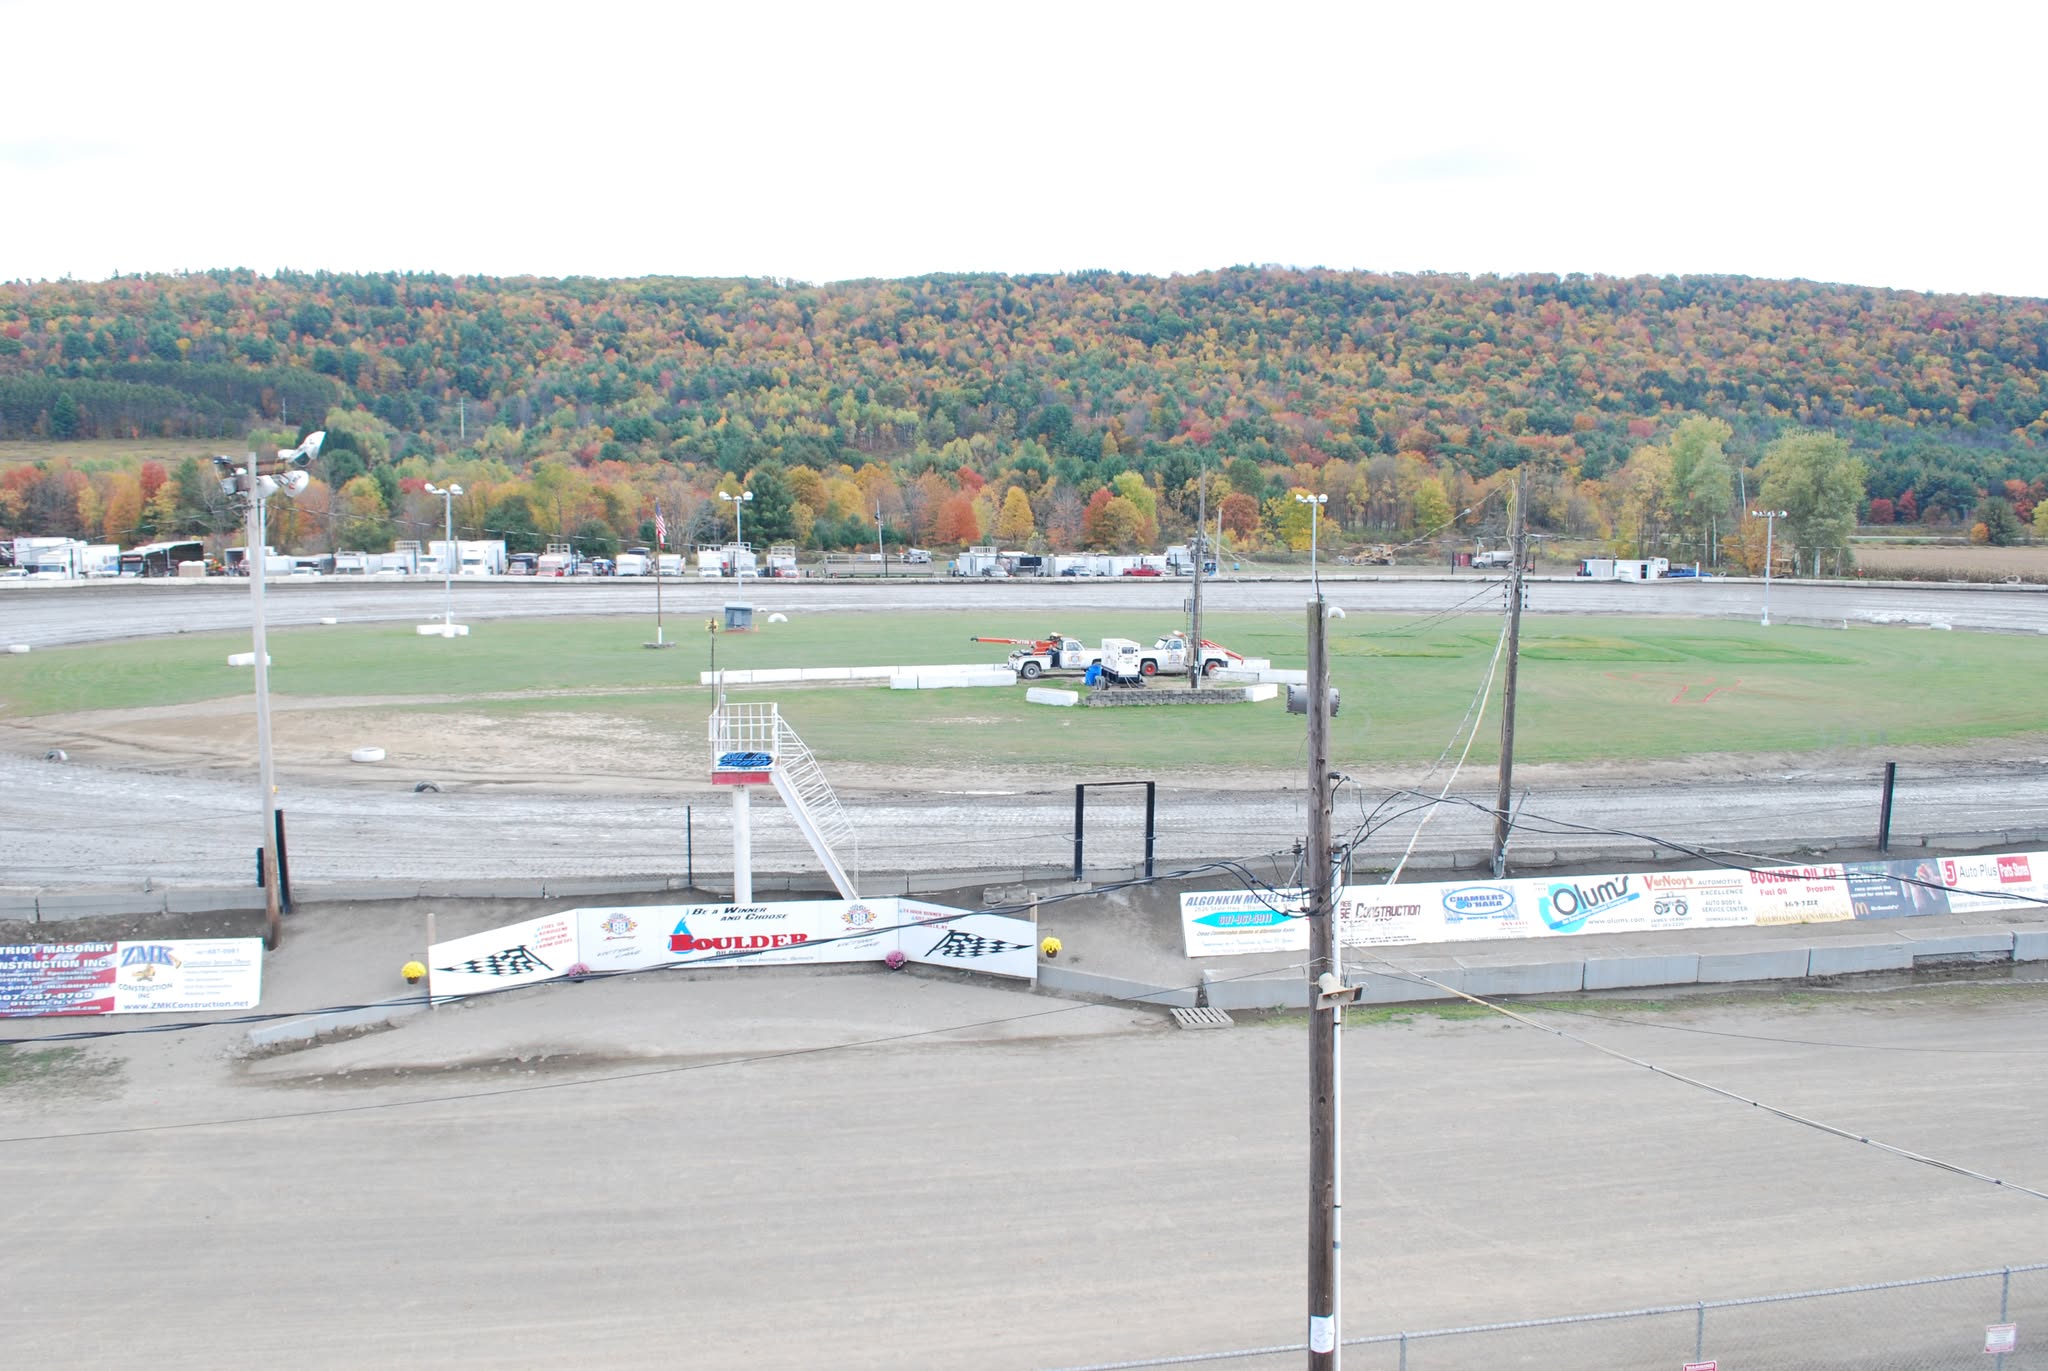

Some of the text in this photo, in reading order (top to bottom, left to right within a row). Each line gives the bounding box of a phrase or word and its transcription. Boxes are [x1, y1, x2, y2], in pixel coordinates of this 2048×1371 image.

[1959, 865, 1978, 878] Auto
[1979, 863, 1998, 877] Plus
[1749, 868, 1801, 885] BOULDER
[1803, 867, 1819, 881] OIL
[1697, 878, 1743, 886] AUTOMOTIVE
[1552, 875, 1630, 916] Olum's
[1699, 888, 1744, 896] EXCELLENCE
[1777, 888, 1788, 896] Oil
[1185, 894, 1243, 906] ALGONKIN
[1243, 892, 1279, 905] MOTEL
[1449, 893, 1505, 903] CHAMBERS
[1466, 900, 1503, 909] O'HARA
[724, 906, 768, 915] WINNER
[720, 912, 790, 922] AND CHOOSE
[668, 933, 809, 952] BOULDER
[43, 944, 114, 954] MASONRY
[119, 944, 175, 968] ZMK
[83, 959, 111, 967] INC.
[118, 982, 173, 992] CONSTRUCTION
[123, 1000, 249, 1011] www.ZMKConstruction.net
